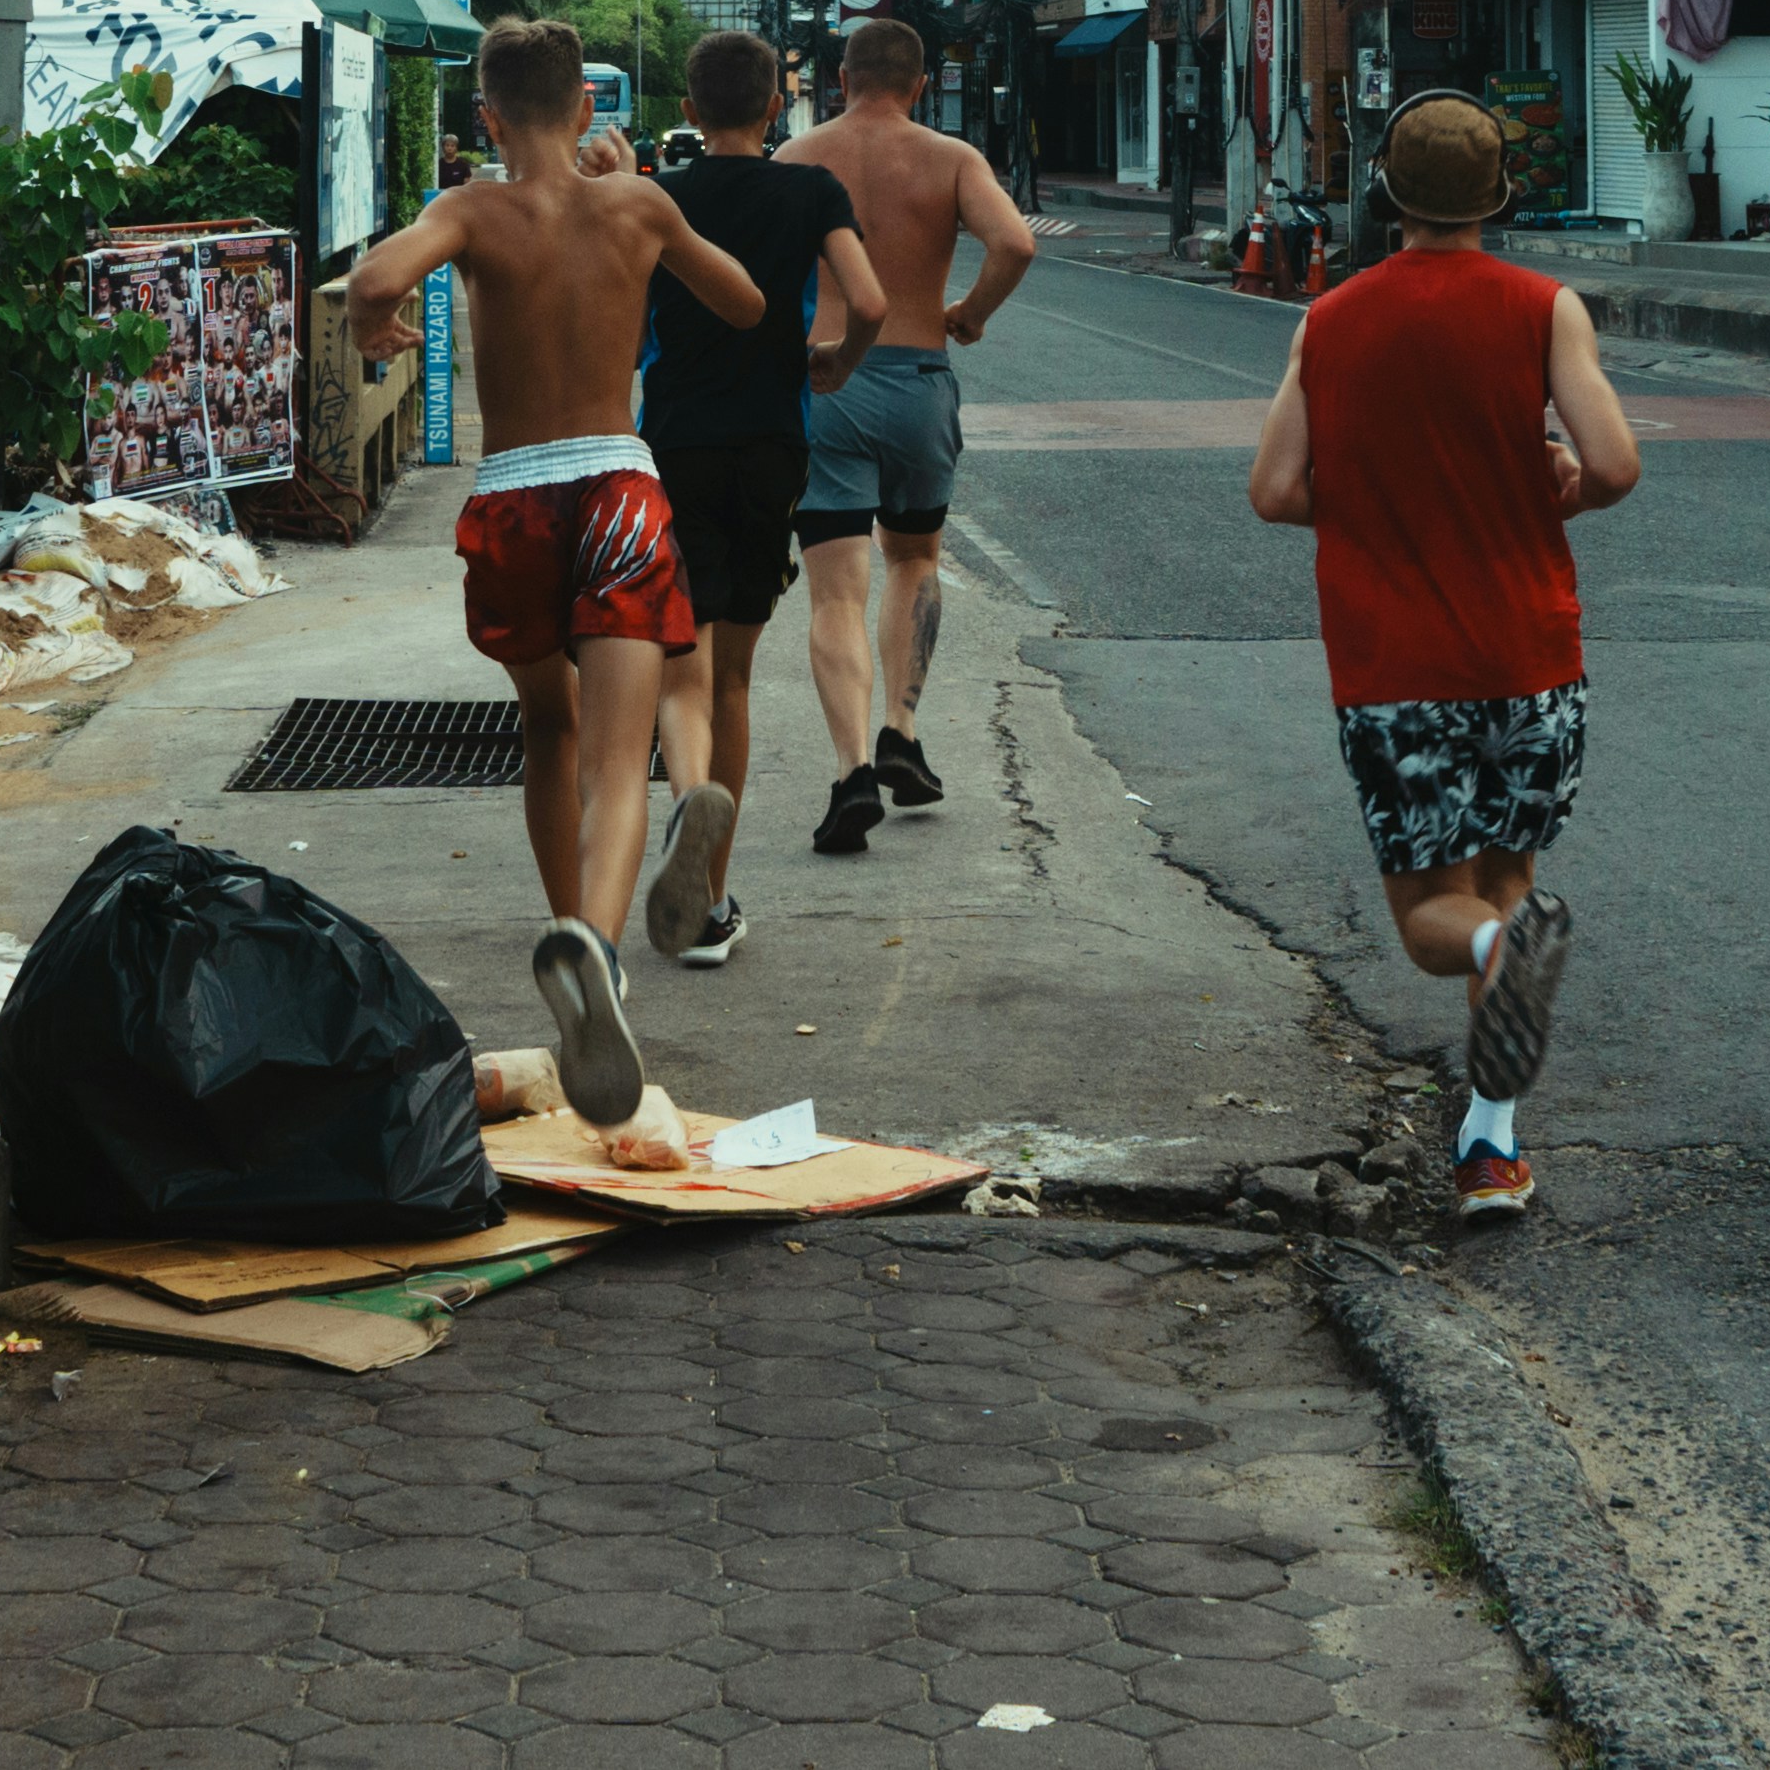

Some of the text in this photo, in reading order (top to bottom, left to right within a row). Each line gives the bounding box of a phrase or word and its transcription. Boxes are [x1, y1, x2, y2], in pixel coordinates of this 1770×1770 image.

[1414, 13, 1457, 30] KING
[1505, 92, 1546, 102] WESTERN FOOD
[157, 256, 180, 268] FIGHTS
[138, 282, 154, 313] 2
[204, 277, 215, 312] 1
[428, 290, 449, 364] HAZARD
[428, 372, 449, 452] TSUNAMI
